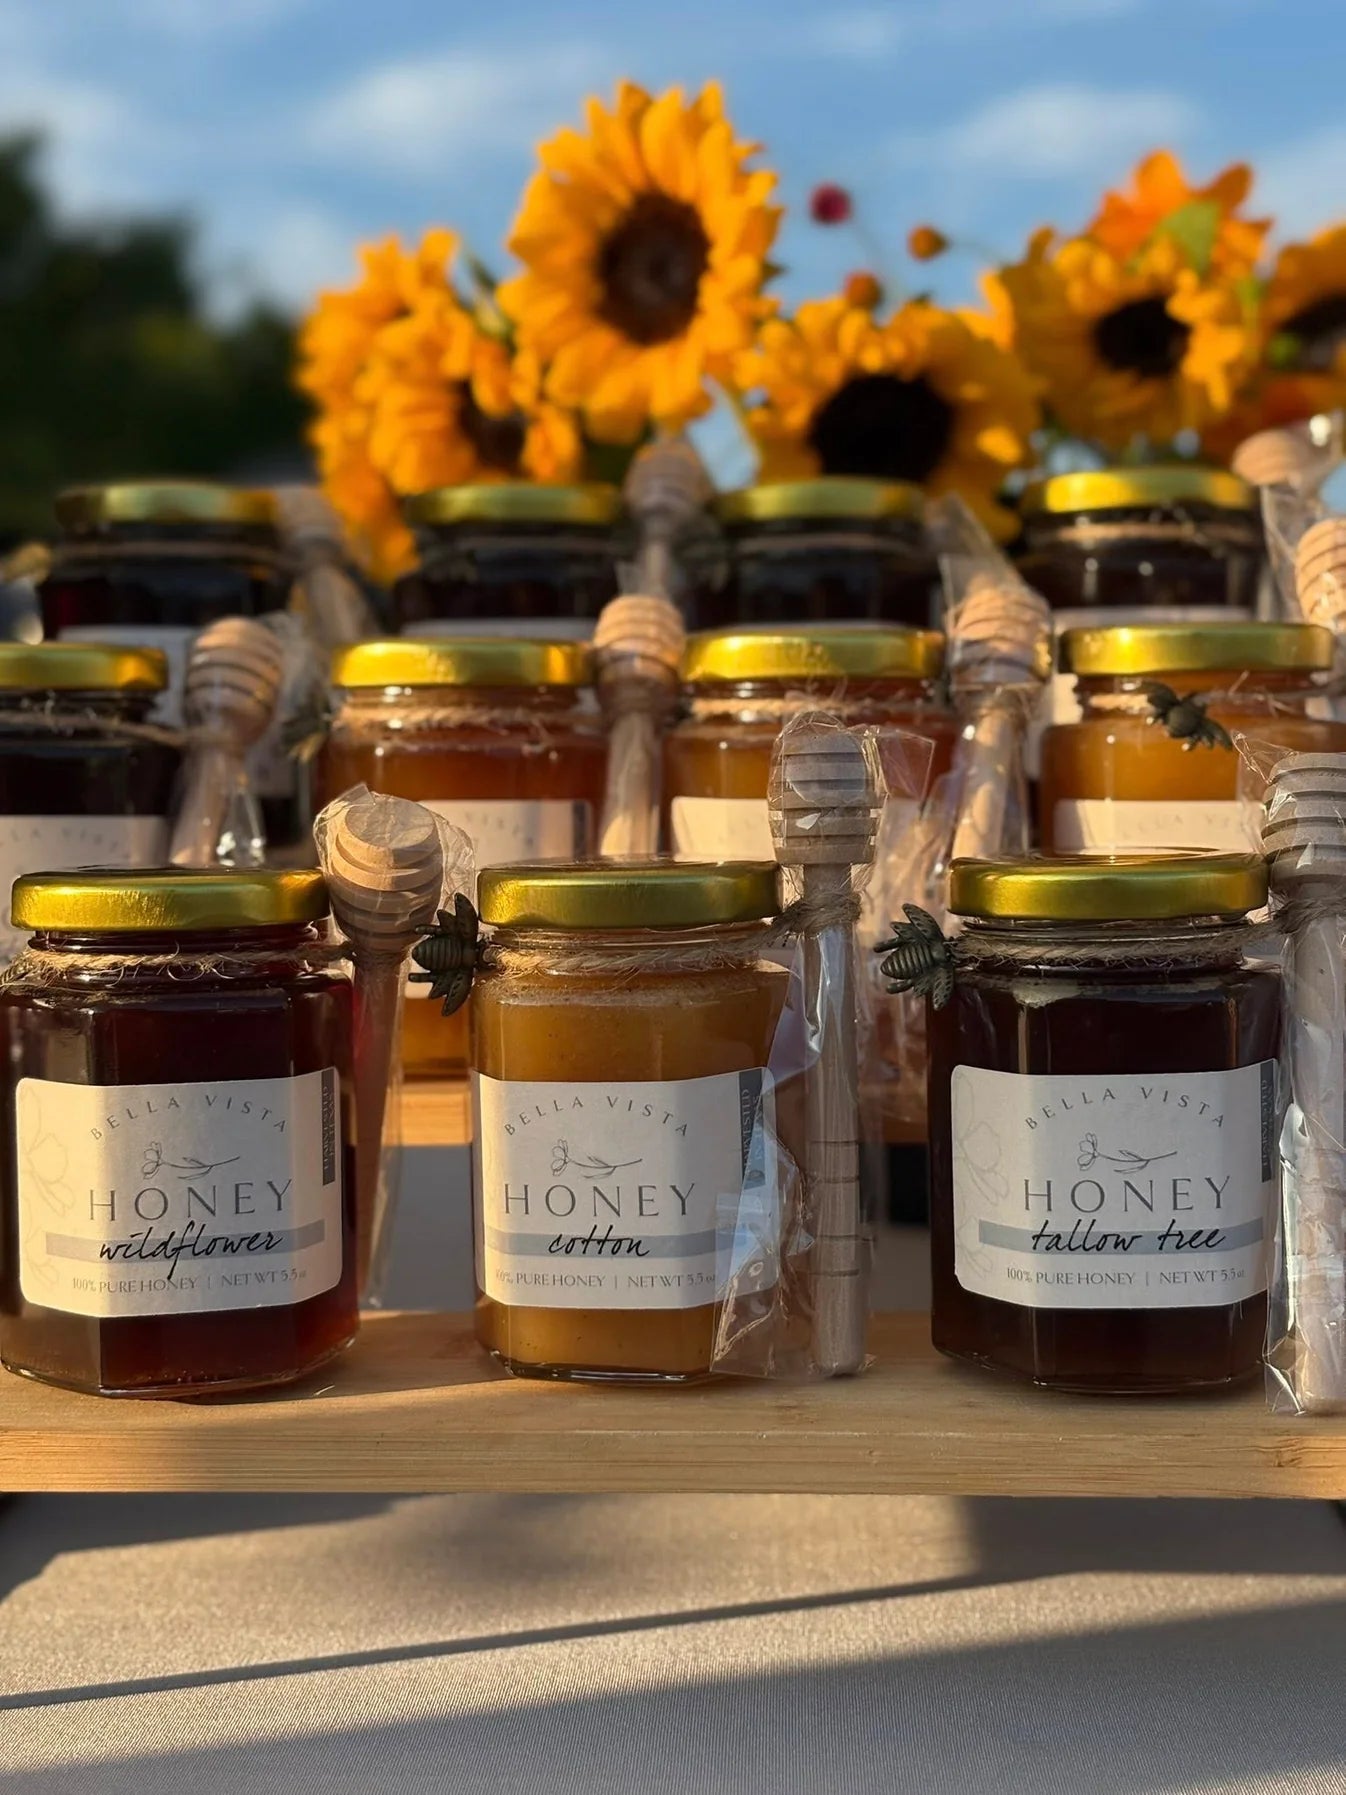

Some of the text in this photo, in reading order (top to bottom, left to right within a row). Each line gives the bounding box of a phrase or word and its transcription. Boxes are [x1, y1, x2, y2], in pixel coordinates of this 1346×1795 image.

[90, 1094, 287, 1141] BELLA VISTA
[504, 1095, 688, 1137] BELLA VISTA
[1025, 1087, 1116, 1130] BELLA
[1140, 1086, 1224, 1128] VISTA
[89, 1178, 292, 1222] HONEY
[504, 1182, 696, 1218] HONEY
[1023, 1175, 1231, 1213] HONEY
[99, 1220, 283, 1281] wildflower
[548, 1224, 650, 1257] cotton
[1031, 1218, 1227, 1251] tallow tree
[99, 1280, 137, 1293] PURE
[140, 1277, 198, 1293] HONEY
[221, 1273, 251, 1287] NET
[253, 1270, 279, 1284] WT
[516, 1271, 550, 1286] PURE
[552, 1273, 605, 1288] HONEY
[628, 1274, 657, 1288] NET
[659, 1273, 684, 1287] WT
[1007, 1267, 1033, 1283] 100%
[1035, 1271, 1074, 1285] PURE
[1077, 1271, 1136, 1285] HONEY
[1159, 1270, 1191, 1284] NET
[1192, 1269, 1218, 1283] WT
